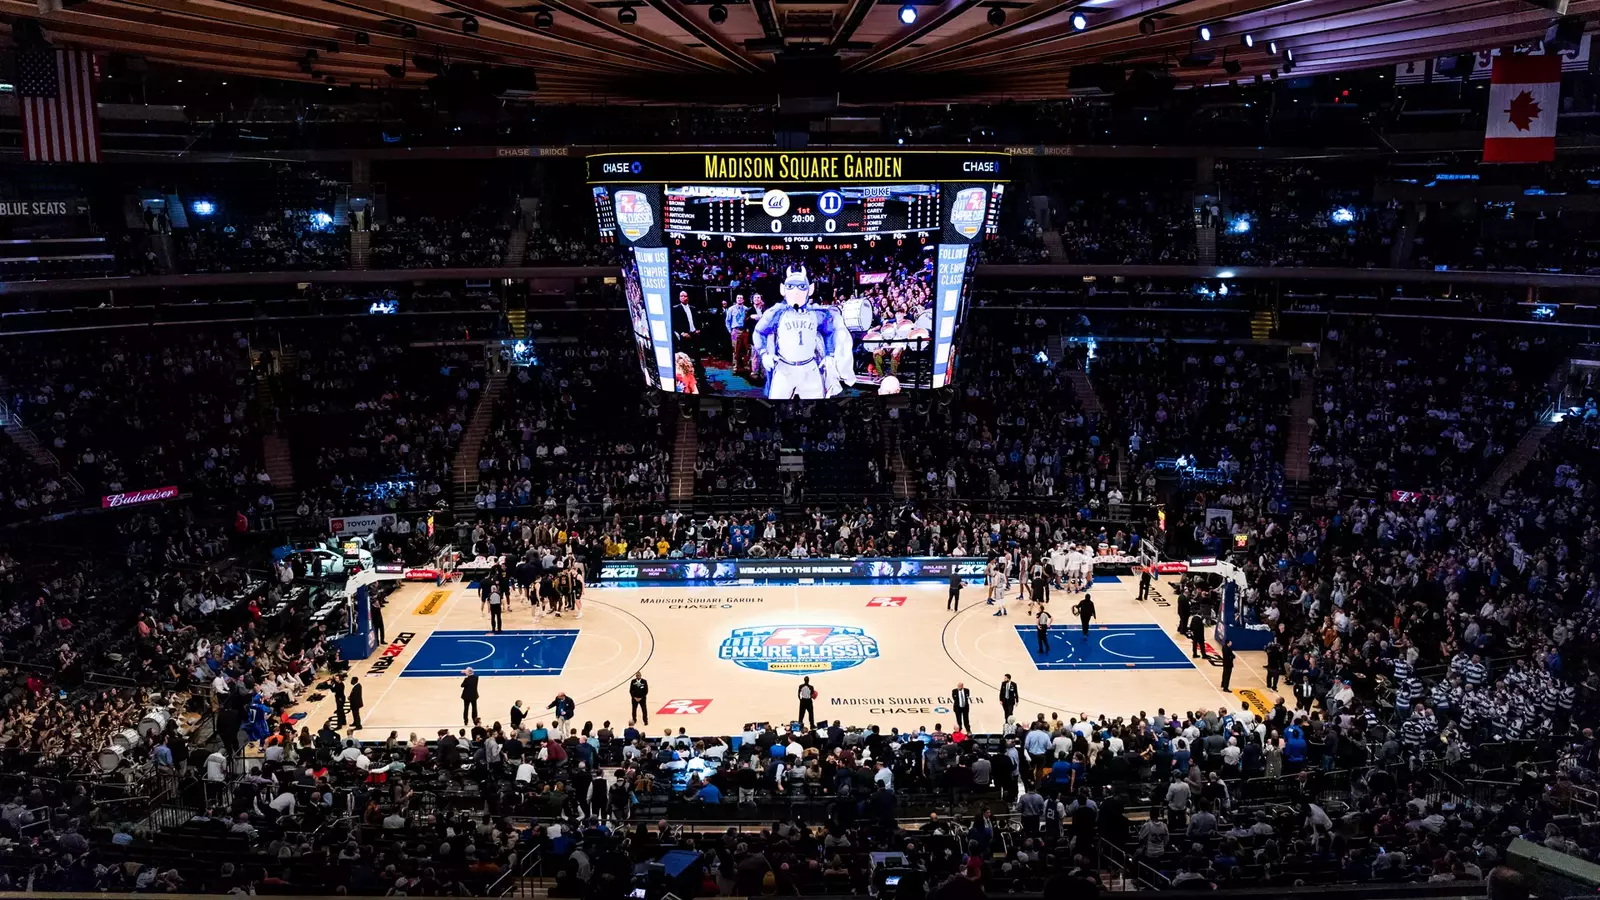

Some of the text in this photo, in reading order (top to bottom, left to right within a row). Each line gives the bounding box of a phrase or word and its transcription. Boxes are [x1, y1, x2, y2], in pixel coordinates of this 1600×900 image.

[499, 148, 568, 156] CHASE BRIDGE
[1004, 147, 1034, 155] CHASE
[603, 163, 630, 173] CHASE
[705, 154, 902, 179] MADISON SQUARE GARDEN
[963, 161, 994, 172] CHASE
[864, 187, 890, 196] DUKE
[768, 196, 784, 208] Cal
[0, 202, 67, 215] BLUE SEATS
[792, 214, 815, 222] 20:00
[771, 219, 782, 233] 0
[825, 218, 836, 233] 0
[784, 320, 815, 331] DUKE
[106, 489, 174, 507] Budweiser
[601, 568, 639, 578] 2K20
[959, 564, 987, 575] 2K2
[722, 645, 878, 658] EMPIRE CLASSIC
[831, 697, 884, 706] MADISON
[889, 697, 934, 705] SQUARE
